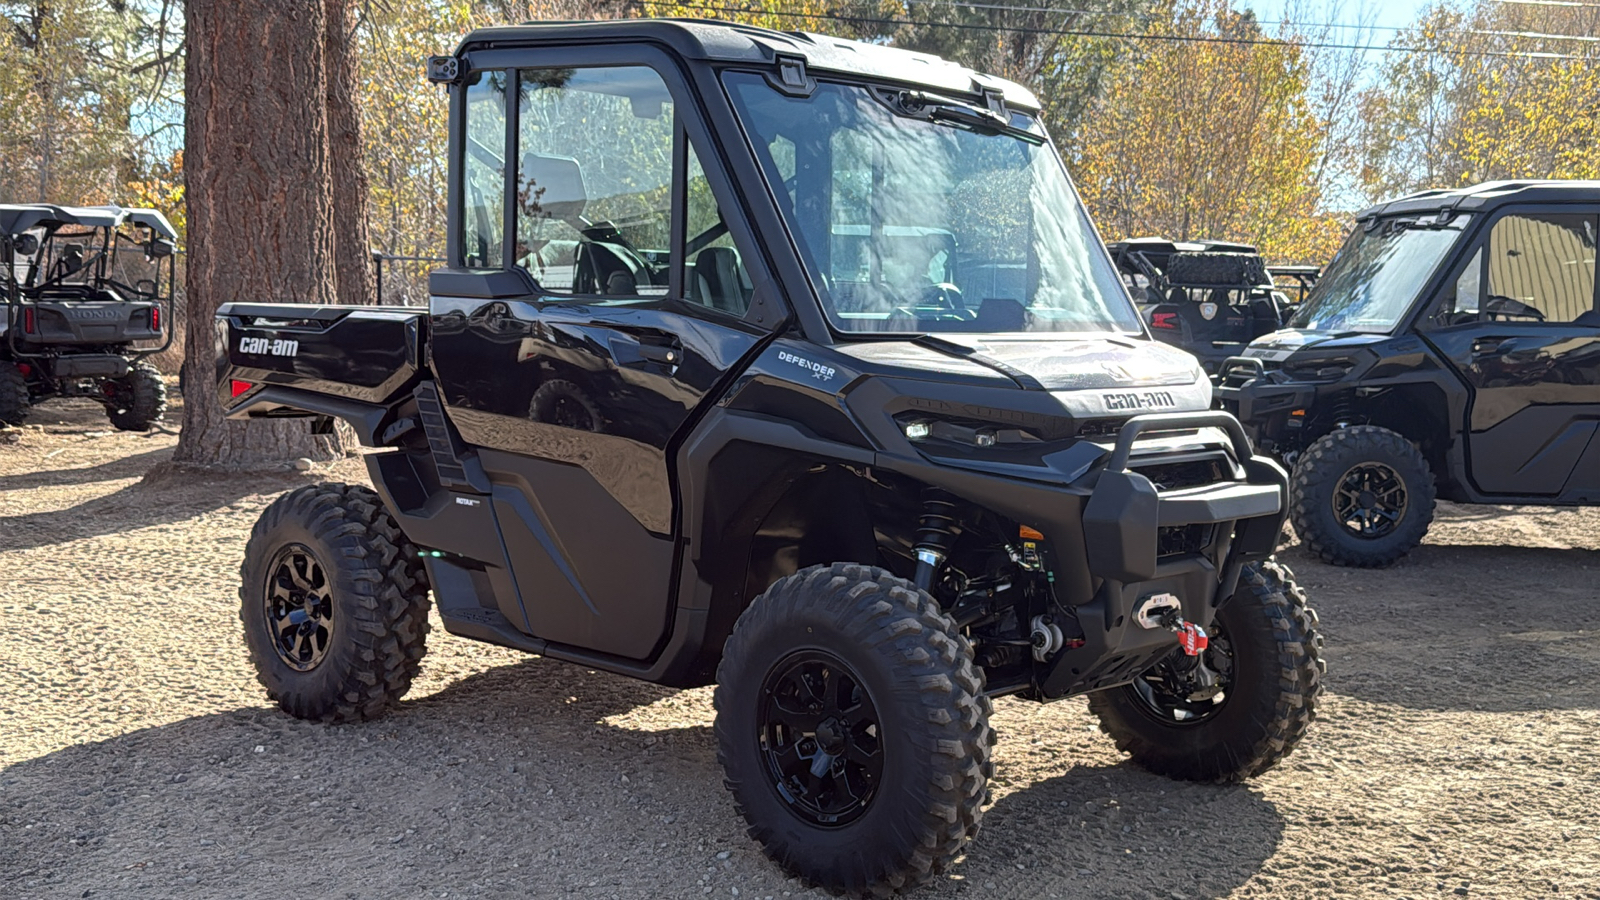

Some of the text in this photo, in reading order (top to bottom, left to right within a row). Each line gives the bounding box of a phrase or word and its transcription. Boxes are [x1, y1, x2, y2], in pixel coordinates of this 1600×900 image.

[69, 309, 124, 320] HONDA
[239, 337, 299, 357] can-am
[778, 351, 836, 377] DEFENDER
[811, 372, 832, 382] XT
[1102, 391, 1175, 409] can-am
